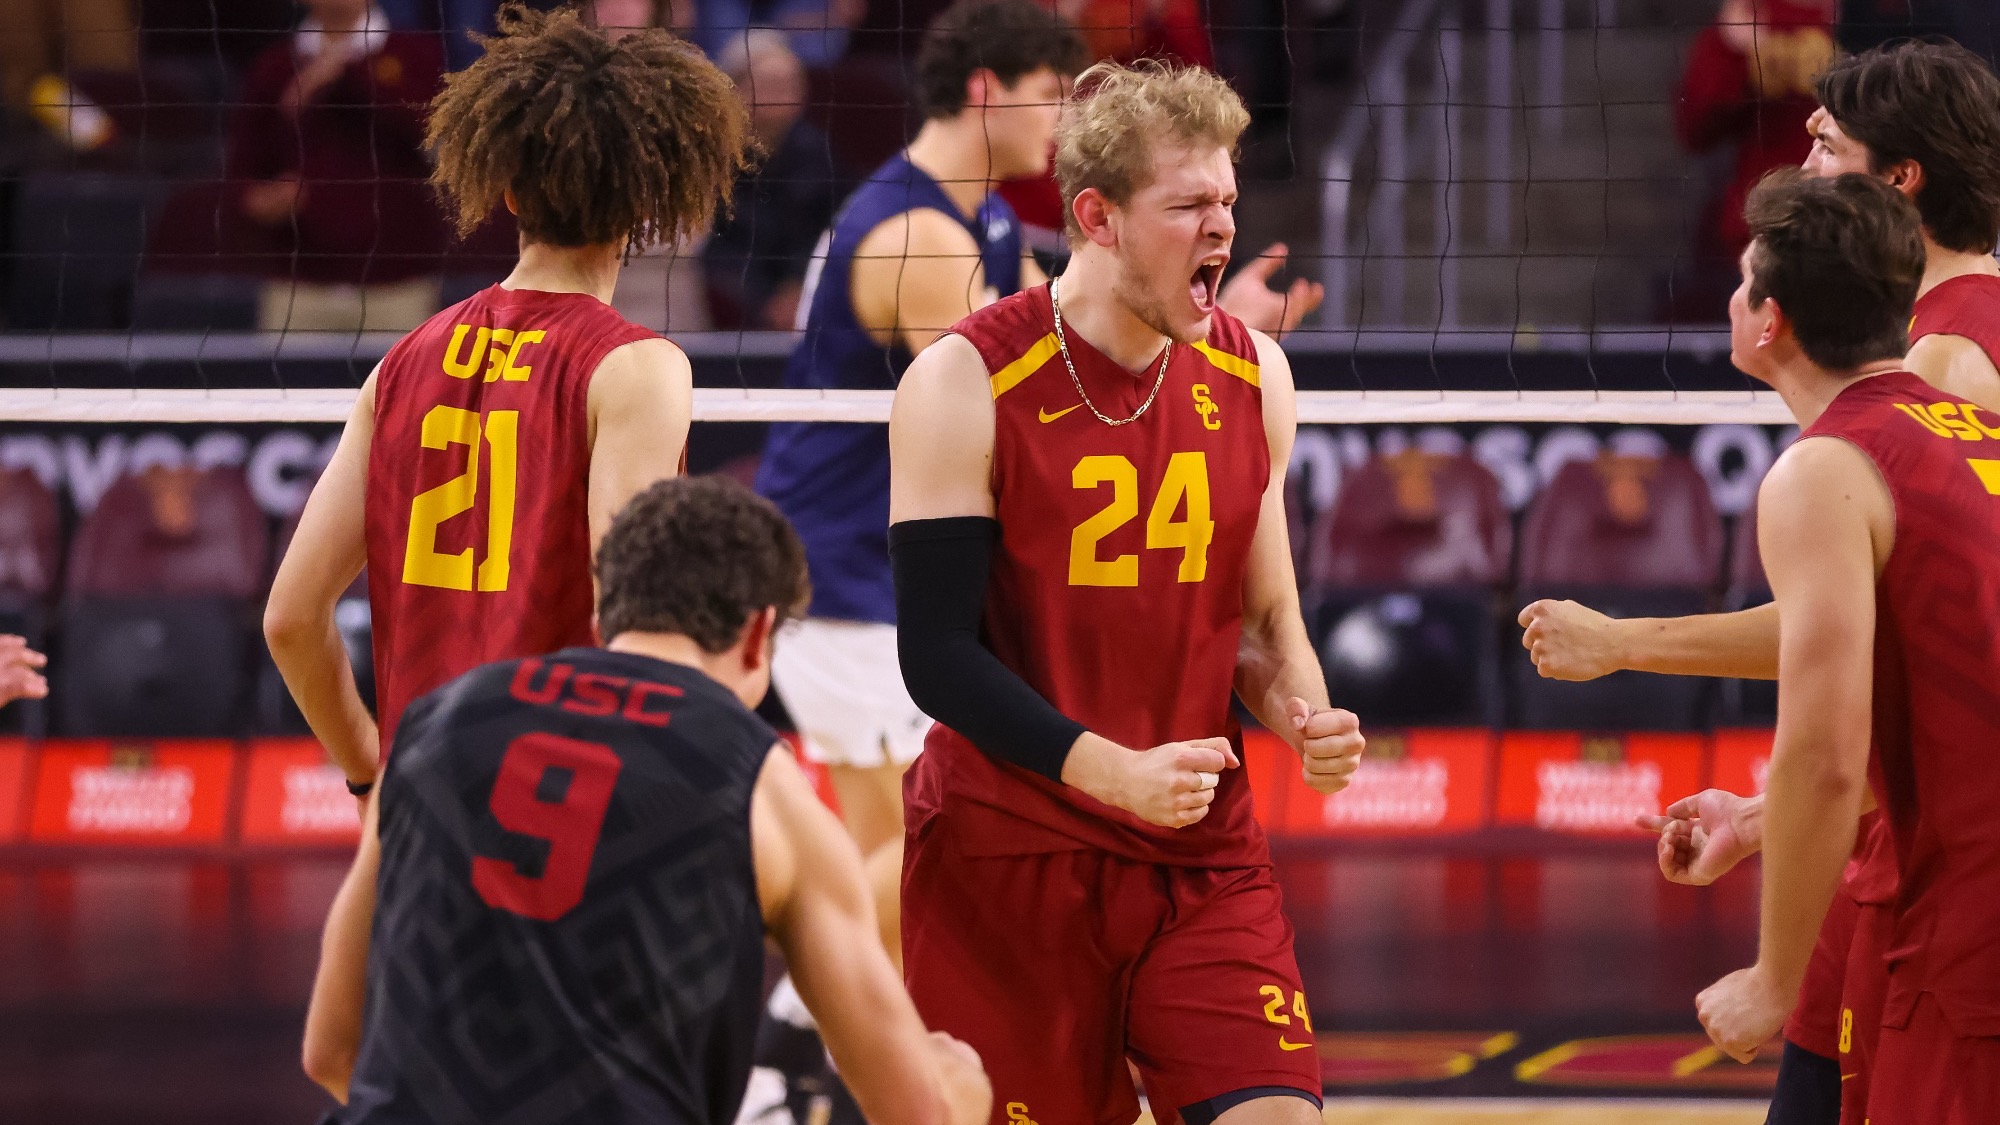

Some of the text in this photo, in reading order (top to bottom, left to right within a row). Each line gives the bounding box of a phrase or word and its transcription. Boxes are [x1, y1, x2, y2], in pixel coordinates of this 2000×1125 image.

[442, 324, 547, 383] USC
[1191, 383, 1222, 431] SC
[402, 404, 519, 592] 21
[1068, 451, 1216, 587] 24
[509, 658, 685, 727] USC
[471, 731, 623, 922] 9
[1259, 984, 1312, 1034] 24
[1006, 1101, 1039, 1125] S
